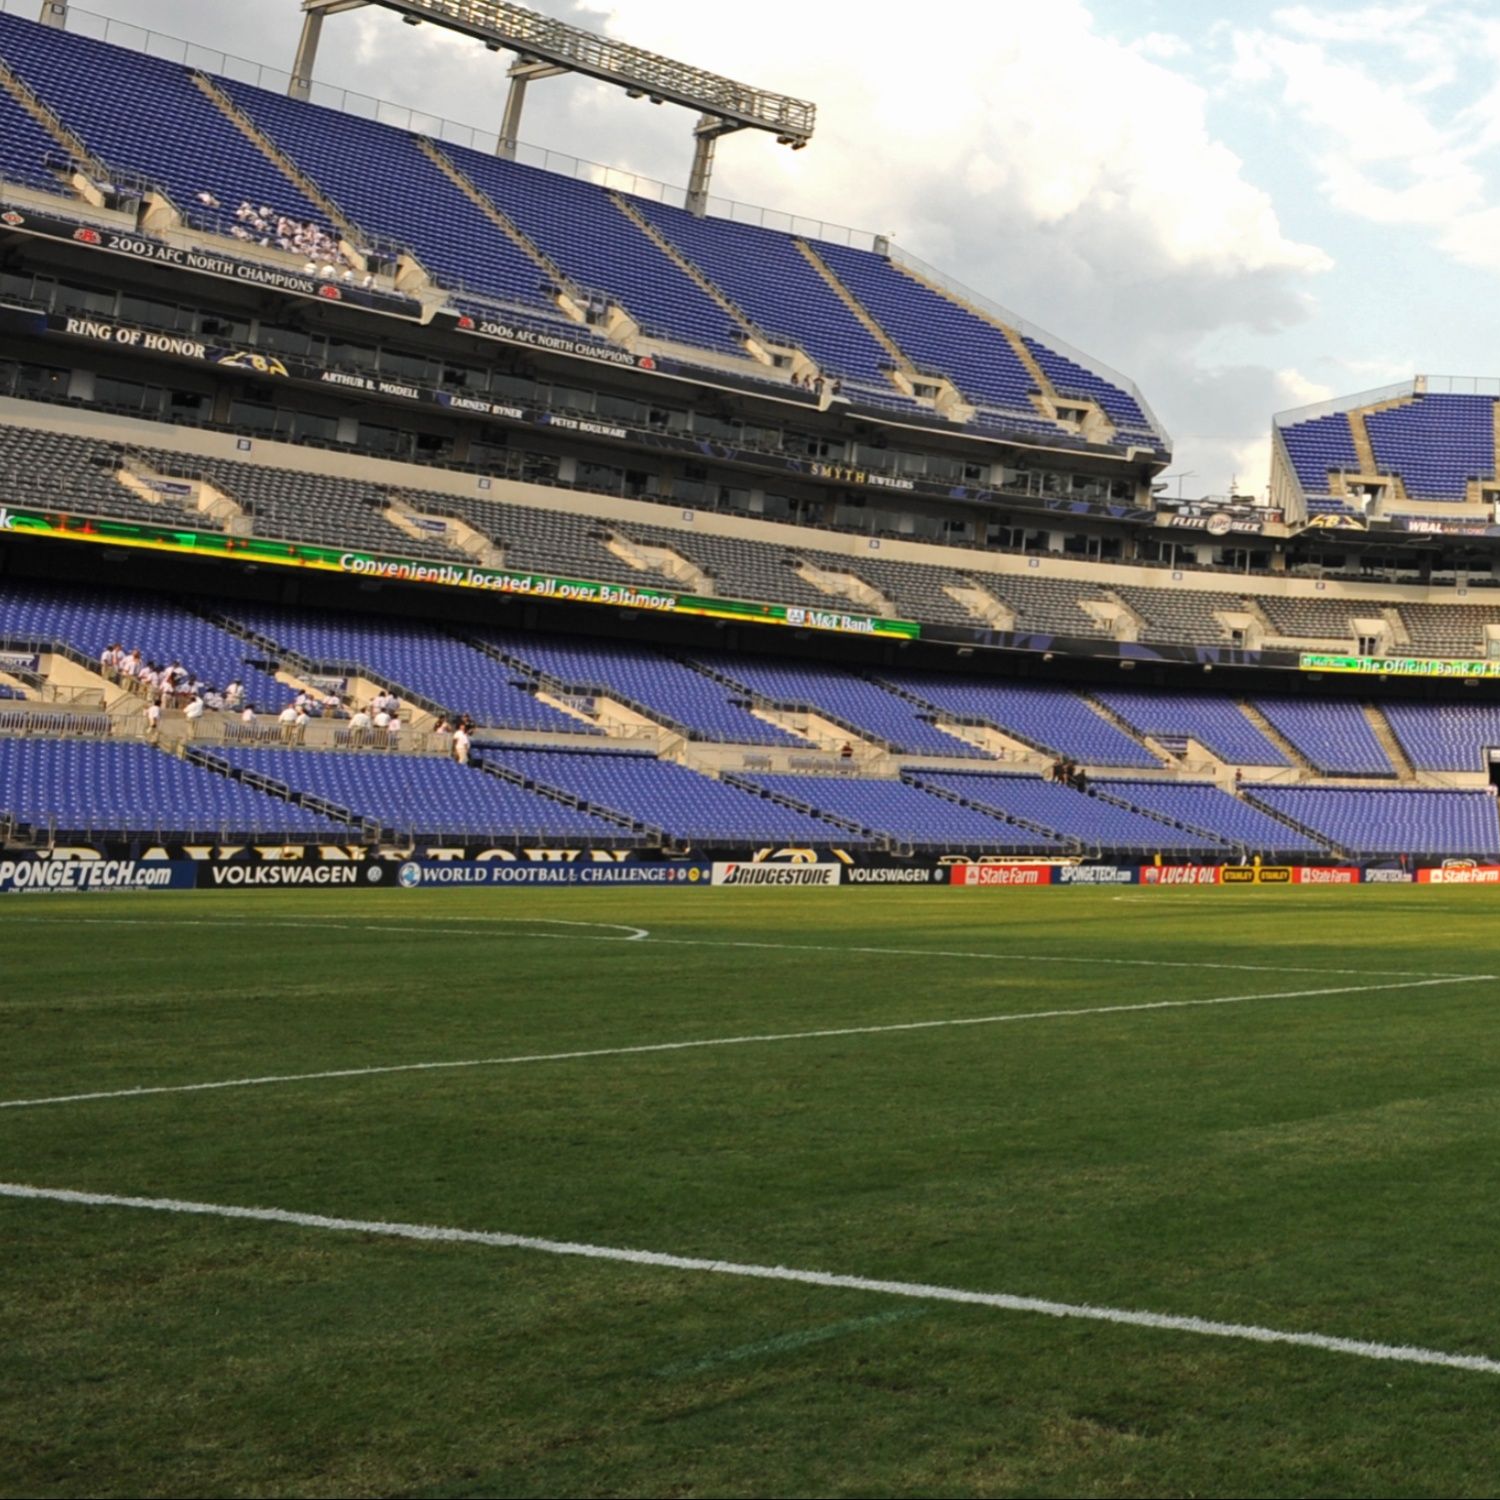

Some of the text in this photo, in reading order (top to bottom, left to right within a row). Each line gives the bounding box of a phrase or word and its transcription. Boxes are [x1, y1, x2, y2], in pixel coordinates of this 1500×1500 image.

[108, 236, 314, 293] 2003 AFC NORTH CHAMPIONS
[66, 318, 206, 359] RING OF HONOR
[479, 321, 635, 365] 2006 AFC NORTH CHAMPIONS
[321, 371, 365, 388] ARTHUR
[379, 382, 420, 399] MODELL
[450, 396, 491, 413] EARNEST
[550, 416, 579, 429] PETER
[811, 463, 865, 483] SMYTH
[1173, 517, 1206, 529] FLITE
[1408, 521, 1442, 533] WBAL
[340, 553, 676, 608] Conveniently located all over Baltimore
[809, 611, 875, 632] M&T Bank
[1383, 659, 1432, 674] Official
[1437, 662, 1469, 675] Bank
[1473, 663, 1487, 676] of
[212, 866, 358, 884] VOLKSWAGEN
[423, 868, 667, 882] WORLD FOOTBALL CHALLENGE
[723, 864, 833, 884] BRIDGESTONE
[848, 868, 930, 882] VOLKSWAGEN
[1060, 866, 1132, 882] SPONGETECH.com
[1160, 867, 1198, 884] LUCAS
[1198, 867, 1216, 883] OIL
